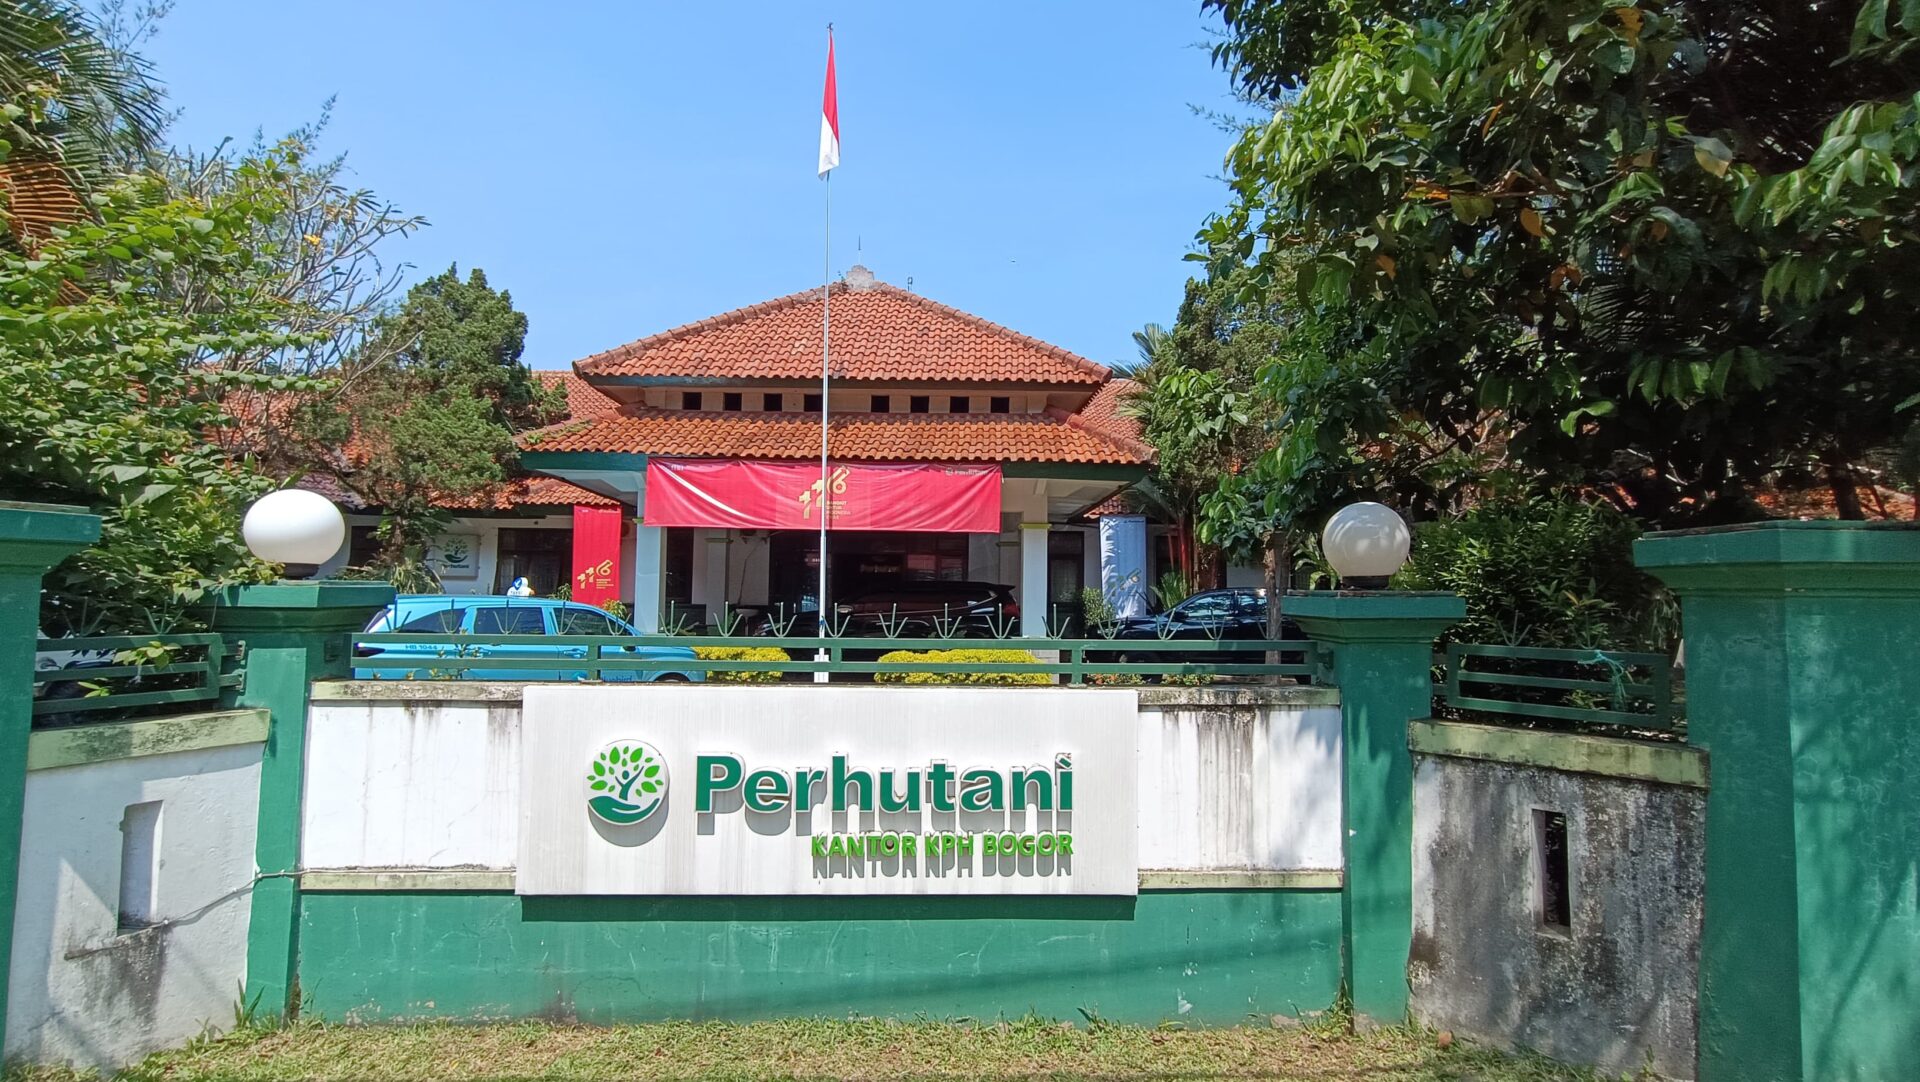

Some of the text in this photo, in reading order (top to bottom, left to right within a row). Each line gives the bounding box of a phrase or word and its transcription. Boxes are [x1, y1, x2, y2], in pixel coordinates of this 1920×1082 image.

[695, 753, 1074, 813] Perhutani
[811, 833, 1074, 858] KANTOR KPH BOGOR
